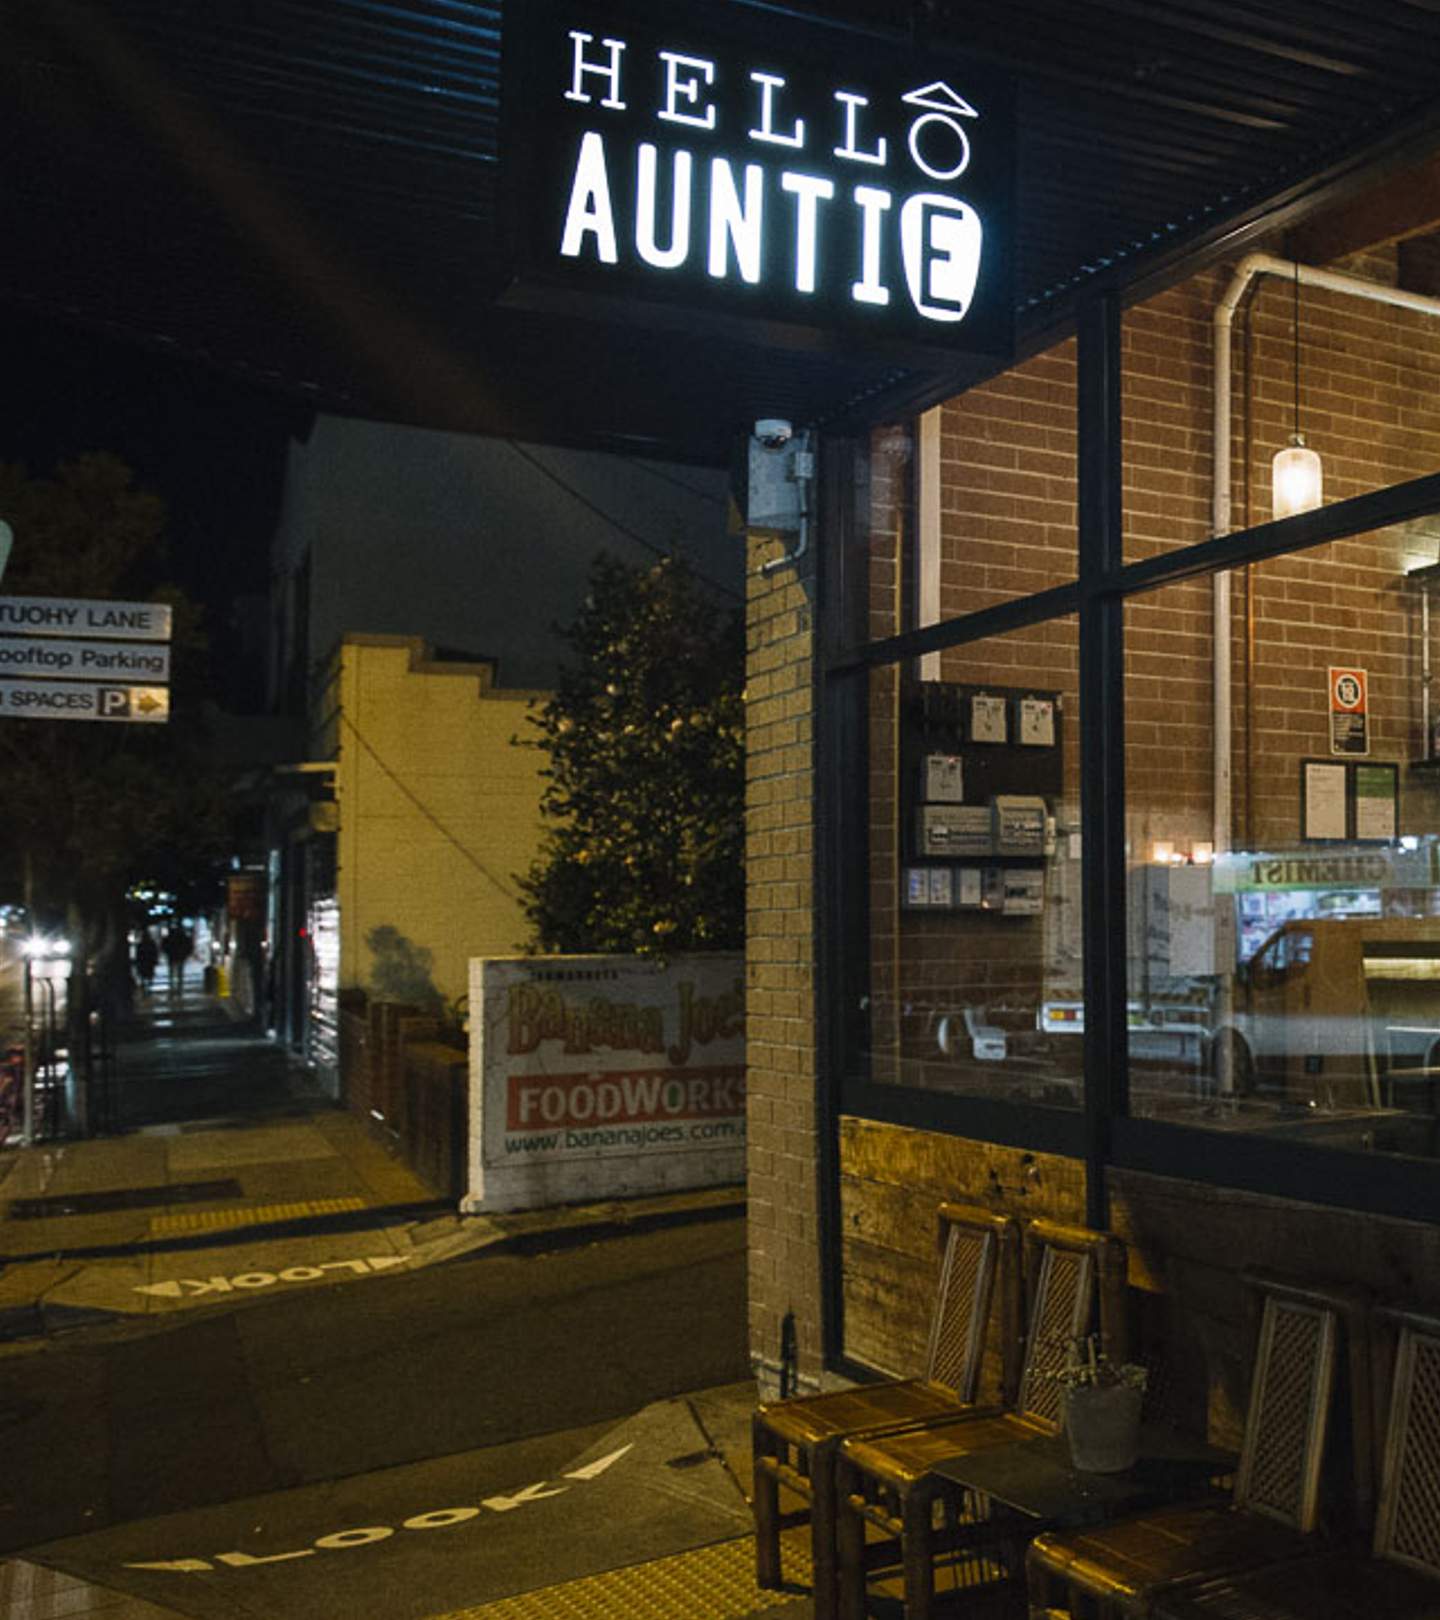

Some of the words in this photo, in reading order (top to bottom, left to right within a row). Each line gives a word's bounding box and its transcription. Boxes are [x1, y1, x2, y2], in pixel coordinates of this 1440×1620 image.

[564, 30, 979, 180] HELLÔ
[560, 131, 983, 322] AUNTIE
[0, 604, 78, 625] TUOHY
[88, 609, 152, 630] LANE
[0, 647, 73, 669] ooftop
[82, 650, 164, 673] Parking
[11, 690, 94, 709] SPACES
[180, 1258, 372, 1297] LOOK
[213, 1480, 571, 1570] LOOK
